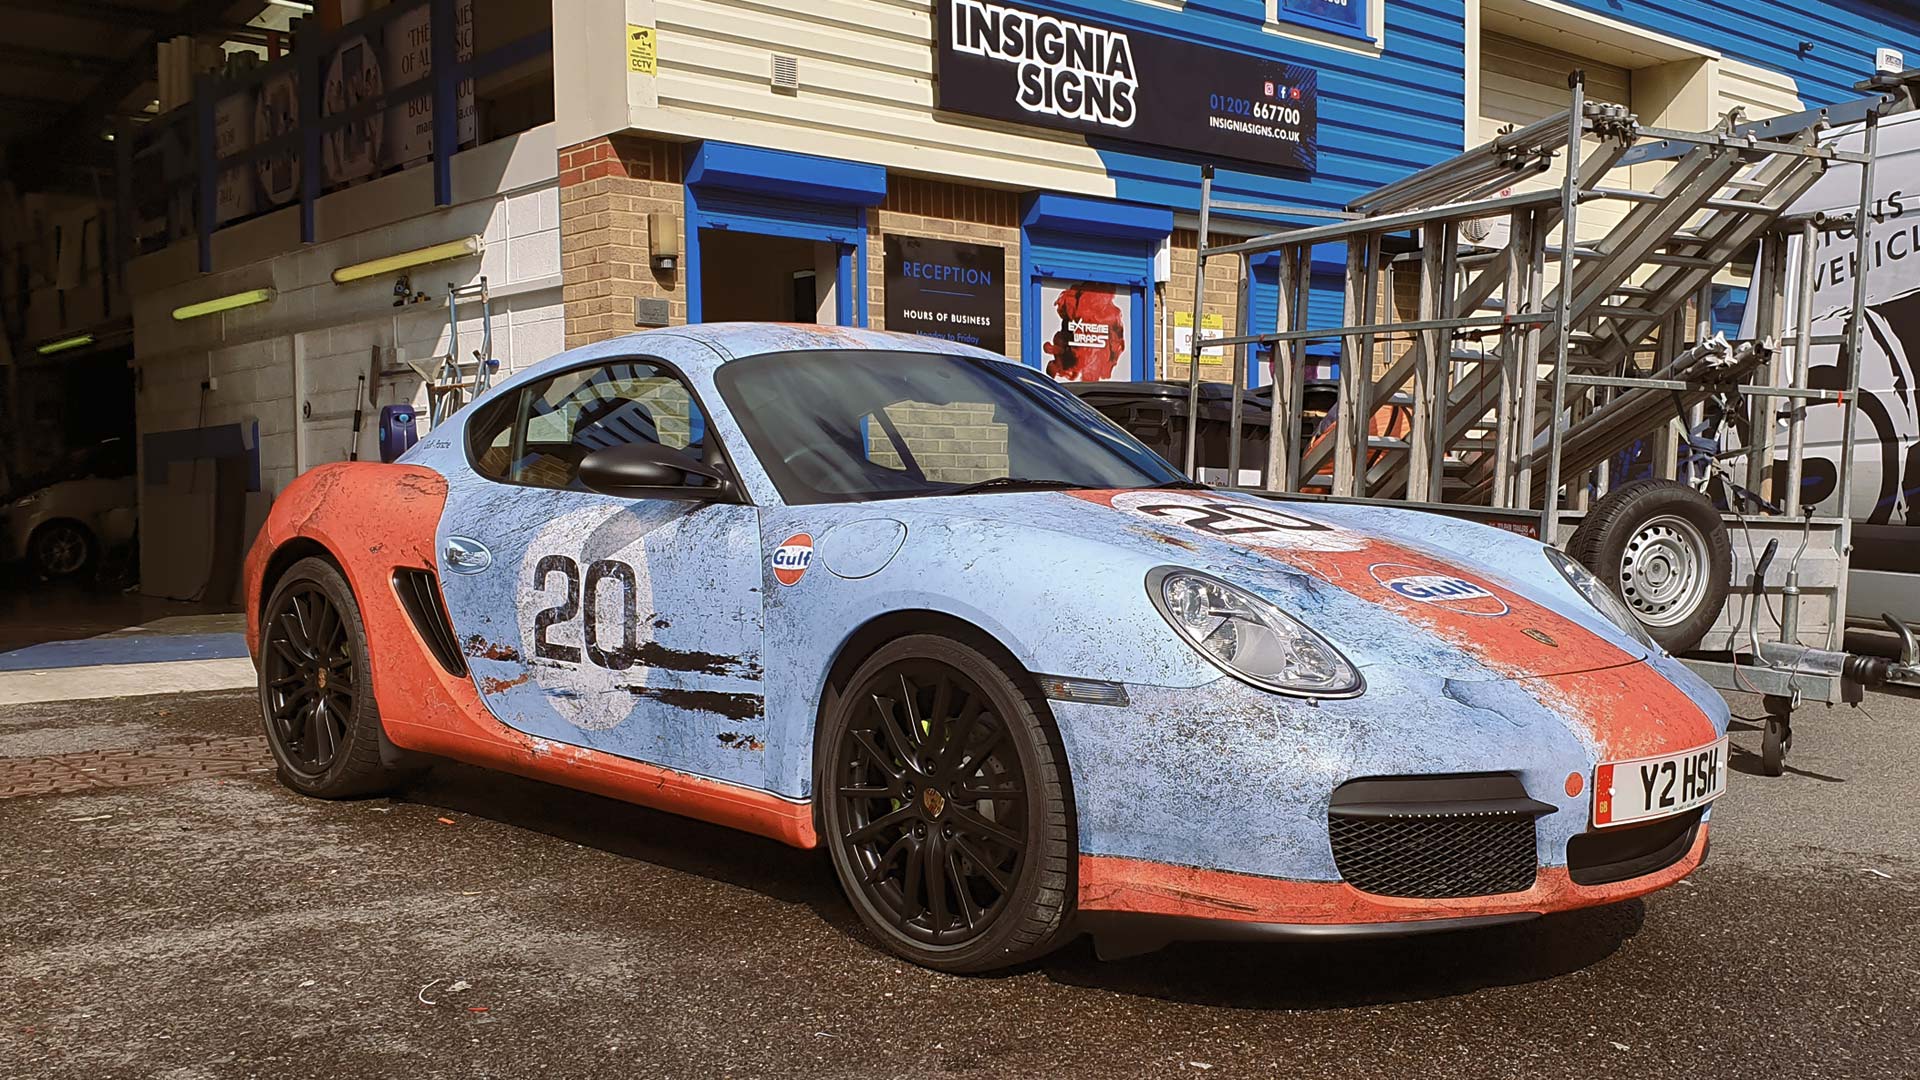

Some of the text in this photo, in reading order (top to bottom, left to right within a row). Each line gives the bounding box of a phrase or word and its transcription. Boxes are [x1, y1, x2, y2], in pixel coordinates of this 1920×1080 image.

[955, 2, 1135, 82] INSIGNIA
[401, 53, 415, 74] OF
[632, 58, 651, 69] CCTV
[1019, 62, 1134, 124] SIGNS
[1209, 94, 1300, 126] 01202 667700
[1209, 116, 1300, 143] INSIGNIASIGNS.CO.UK
[903, 261, 991, 286] RECEPTION
[903, 309, 991, 327] HOURS OF BUSINESS
[1068, 319, 1109, 334] EXTREME
[957, 333, 980, 344] Friday
[1069, 334, 1109, 348] WRAPS
[1136, 504, 1335, 536] 20
[773, 549, 812, 566] Gulf
[1390, 579, 1487, 598] Gulf
[534, 555, 637, 671] 20
[1640, 747, 1719, 811] Y2 HSH
[1600, 801, 1608, 814] GB
